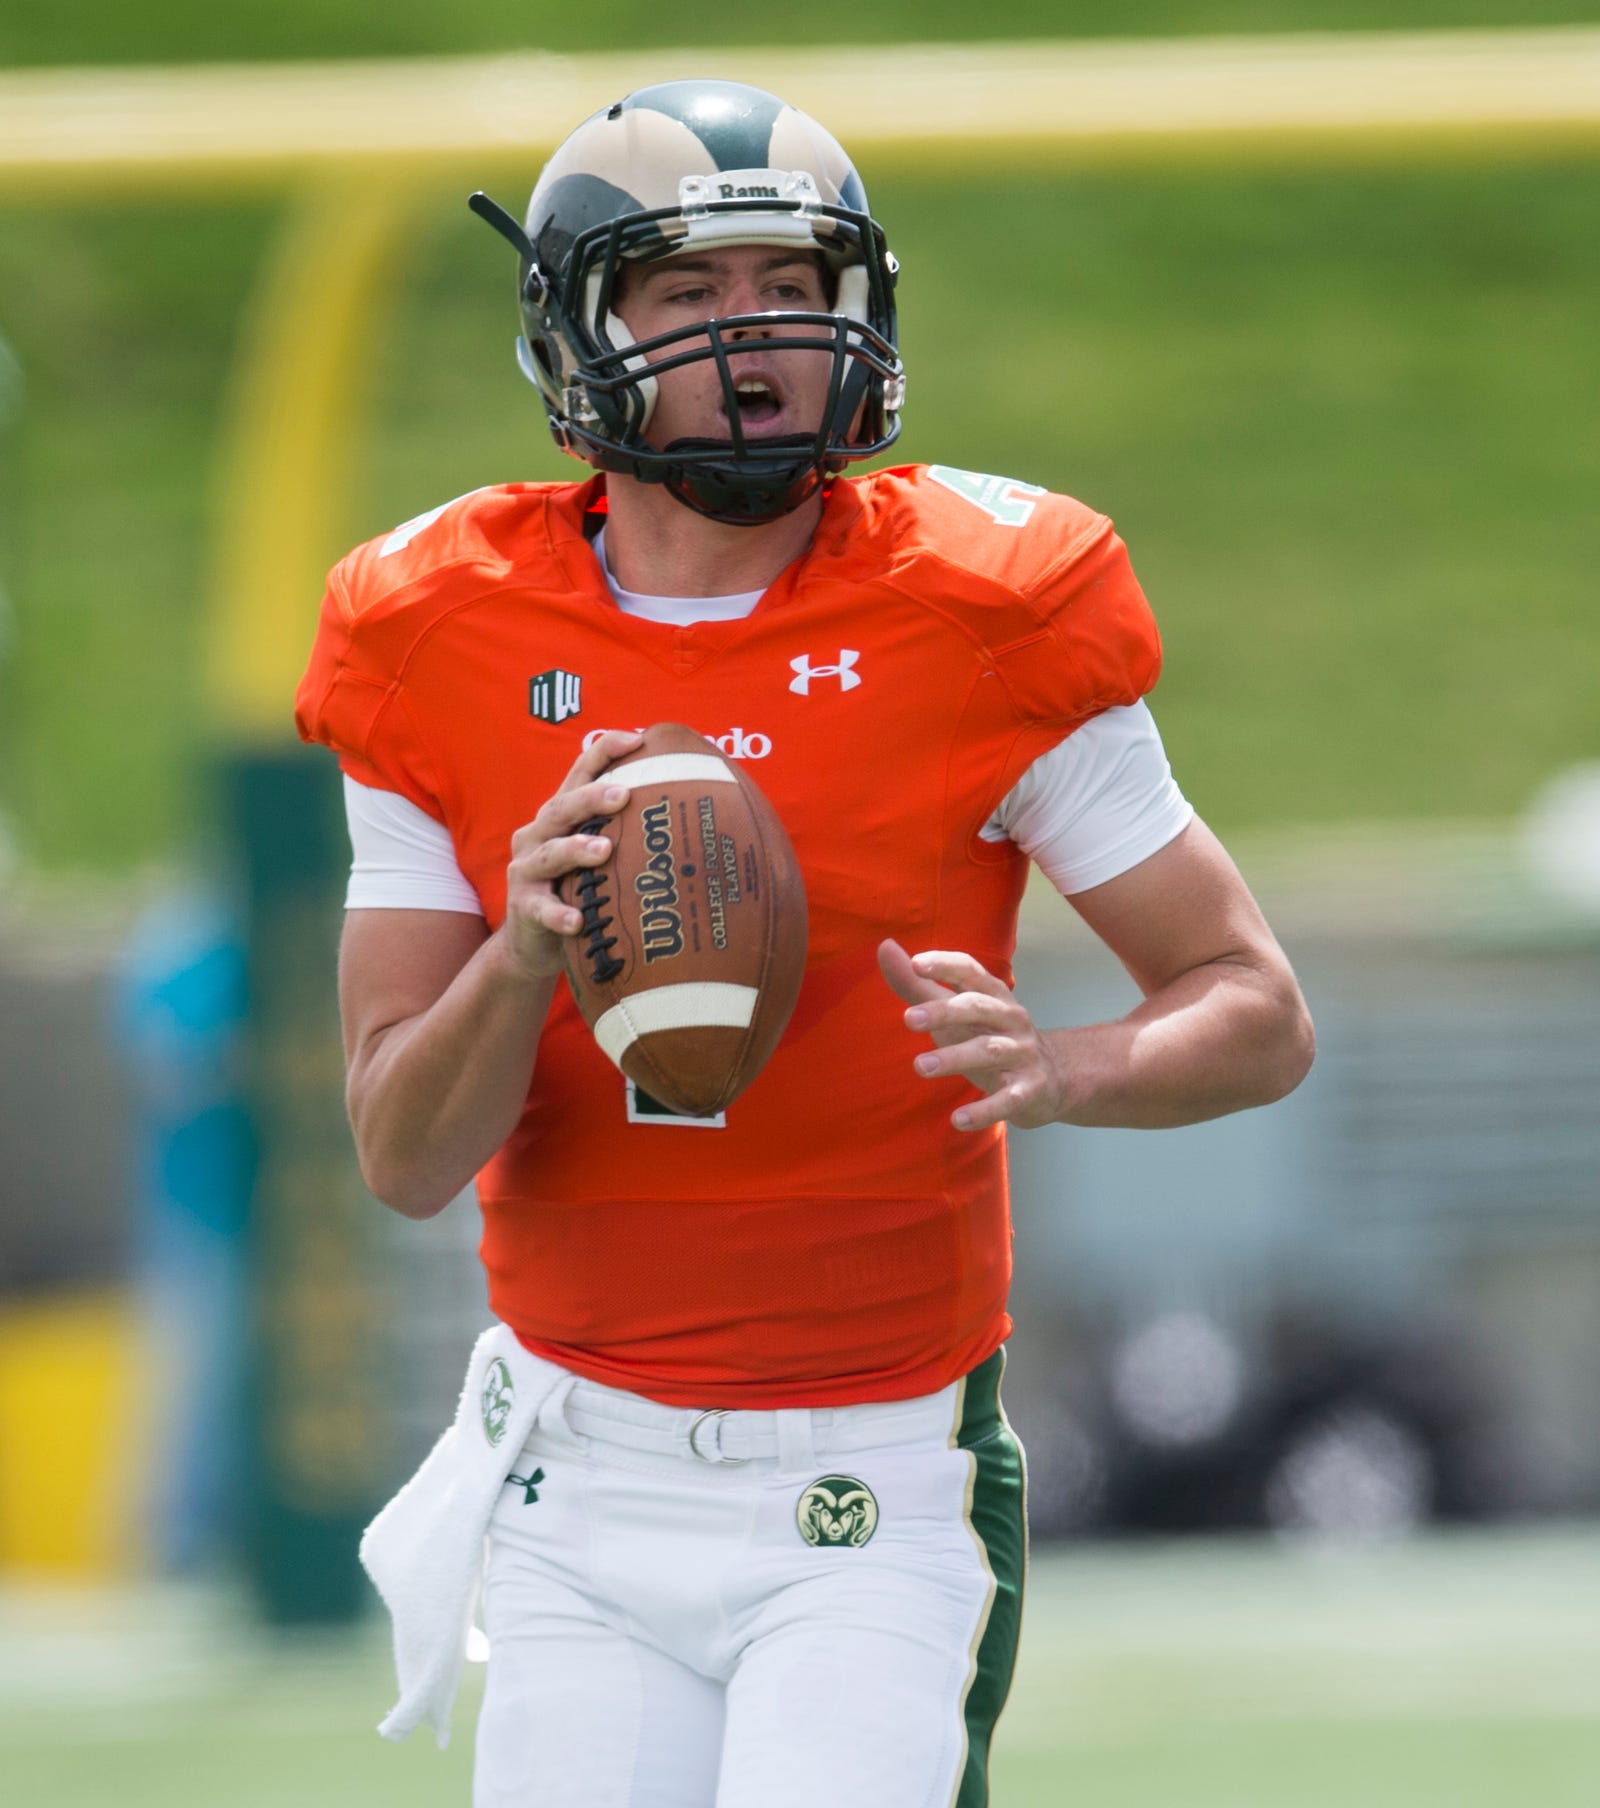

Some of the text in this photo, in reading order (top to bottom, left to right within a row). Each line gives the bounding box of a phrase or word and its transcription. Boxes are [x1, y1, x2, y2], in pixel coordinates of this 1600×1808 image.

[718, 183, 779, 199] Rams
[634, 800, 684, 964] Wilson
[698, 796, 727, 950] COLLEGE FOOTBALL
[721, 834, 740, 903] PLAYOFF
